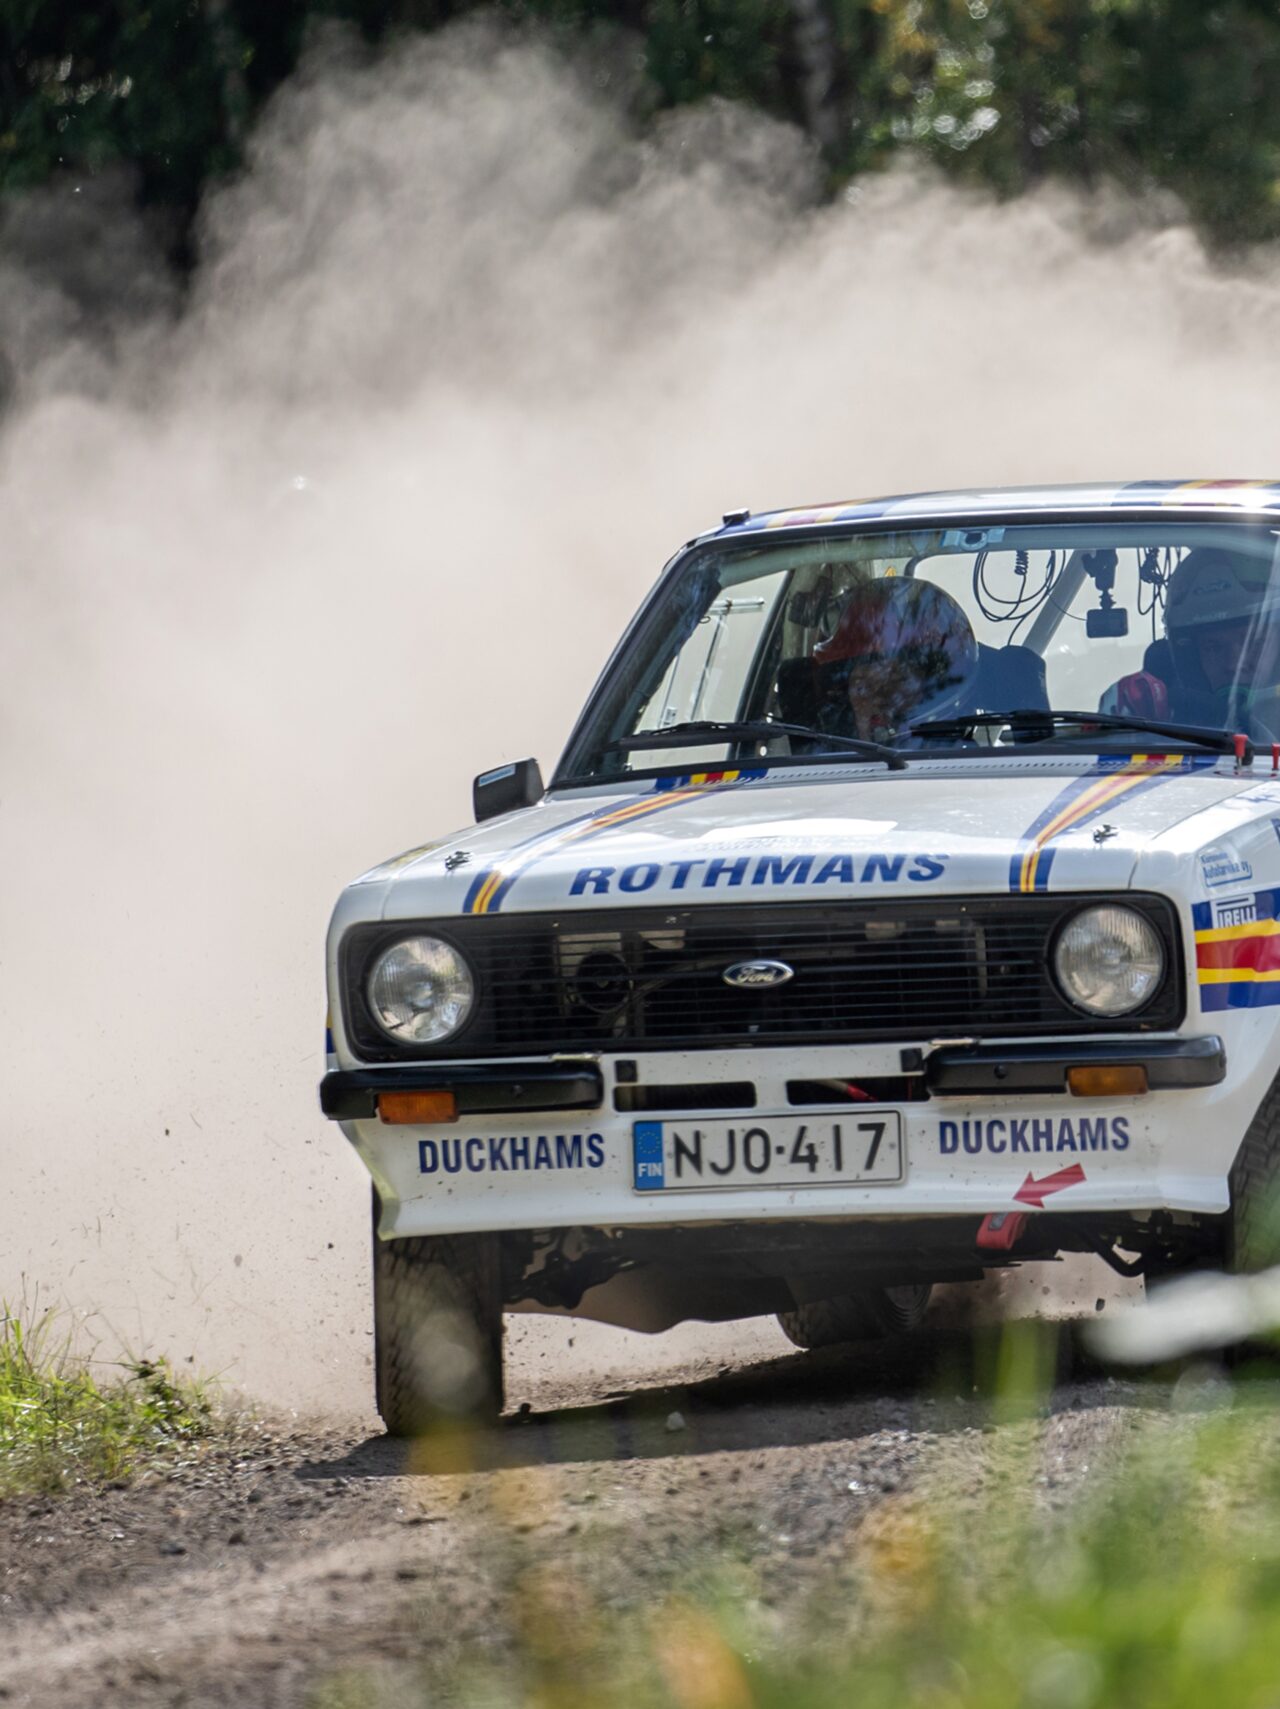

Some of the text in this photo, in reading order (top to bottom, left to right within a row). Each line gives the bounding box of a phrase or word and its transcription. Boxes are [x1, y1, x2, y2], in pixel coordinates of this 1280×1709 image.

[568, 853, 950, 896] ROTHMANS
[1210, 893, 1258, 929] PIRELLI
[736, 966, 778, 985] Ford
[417, 1132, 606, 1175] DUCKHAMS
[637, 1121, 887, 1179] FIN NJO-417
[939, 1115, 1131, 1155] DUCKHAMS
